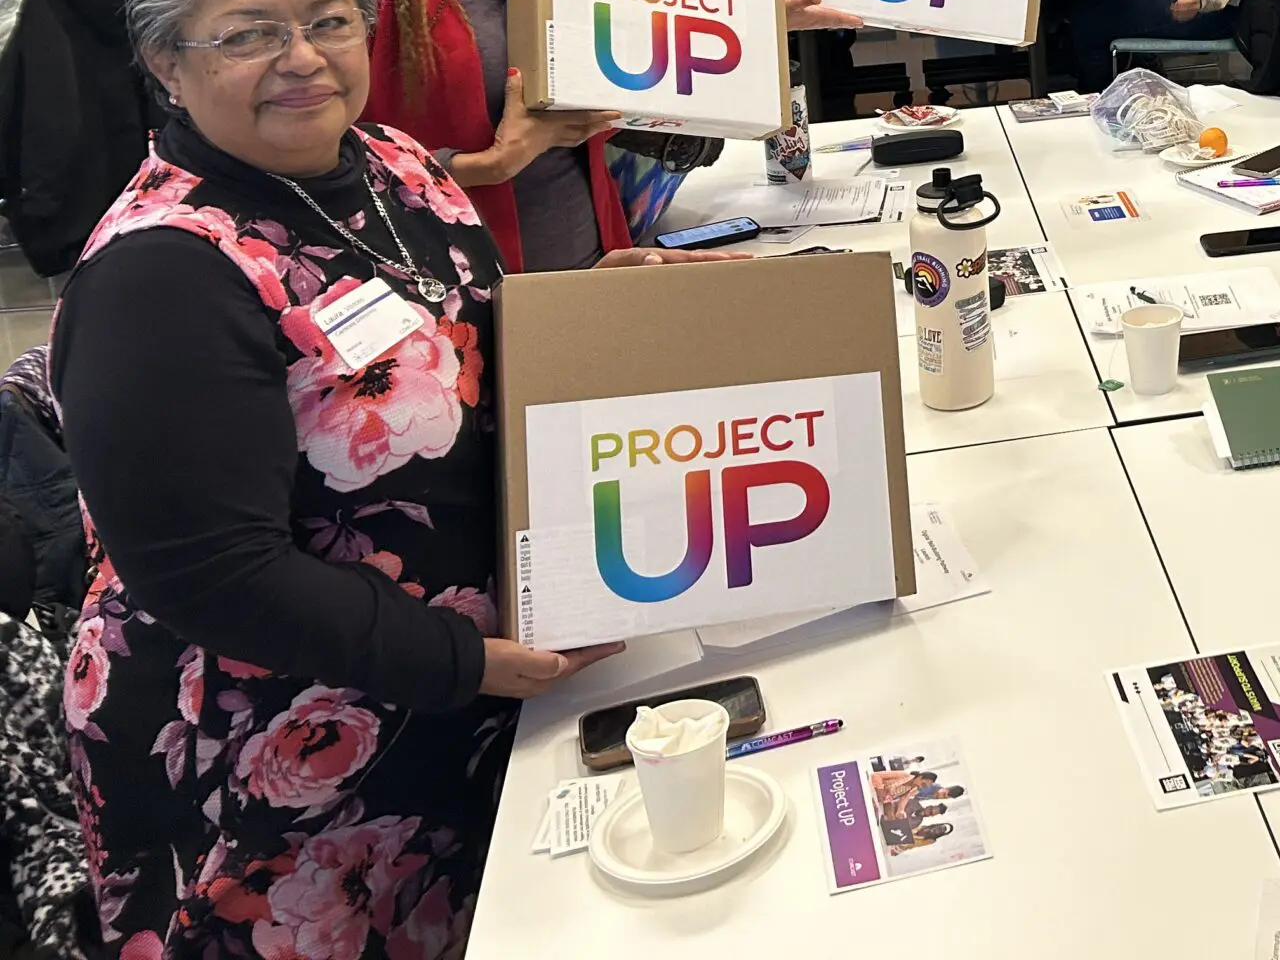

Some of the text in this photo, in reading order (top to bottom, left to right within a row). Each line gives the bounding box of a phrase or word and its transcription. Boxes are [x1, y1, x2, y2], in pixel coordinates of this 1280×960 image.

[593, 1, 743, 96] UP
[932, 260, 948, 288] RUNNING
[924, 327, 942, 344] LOVE
[591, 410, 824, 471] PROJECT
[593, 459, 831, 603] UP
[751, 731, 794, 747] COMCAST
[829, 770, 856, 827] Project UP
